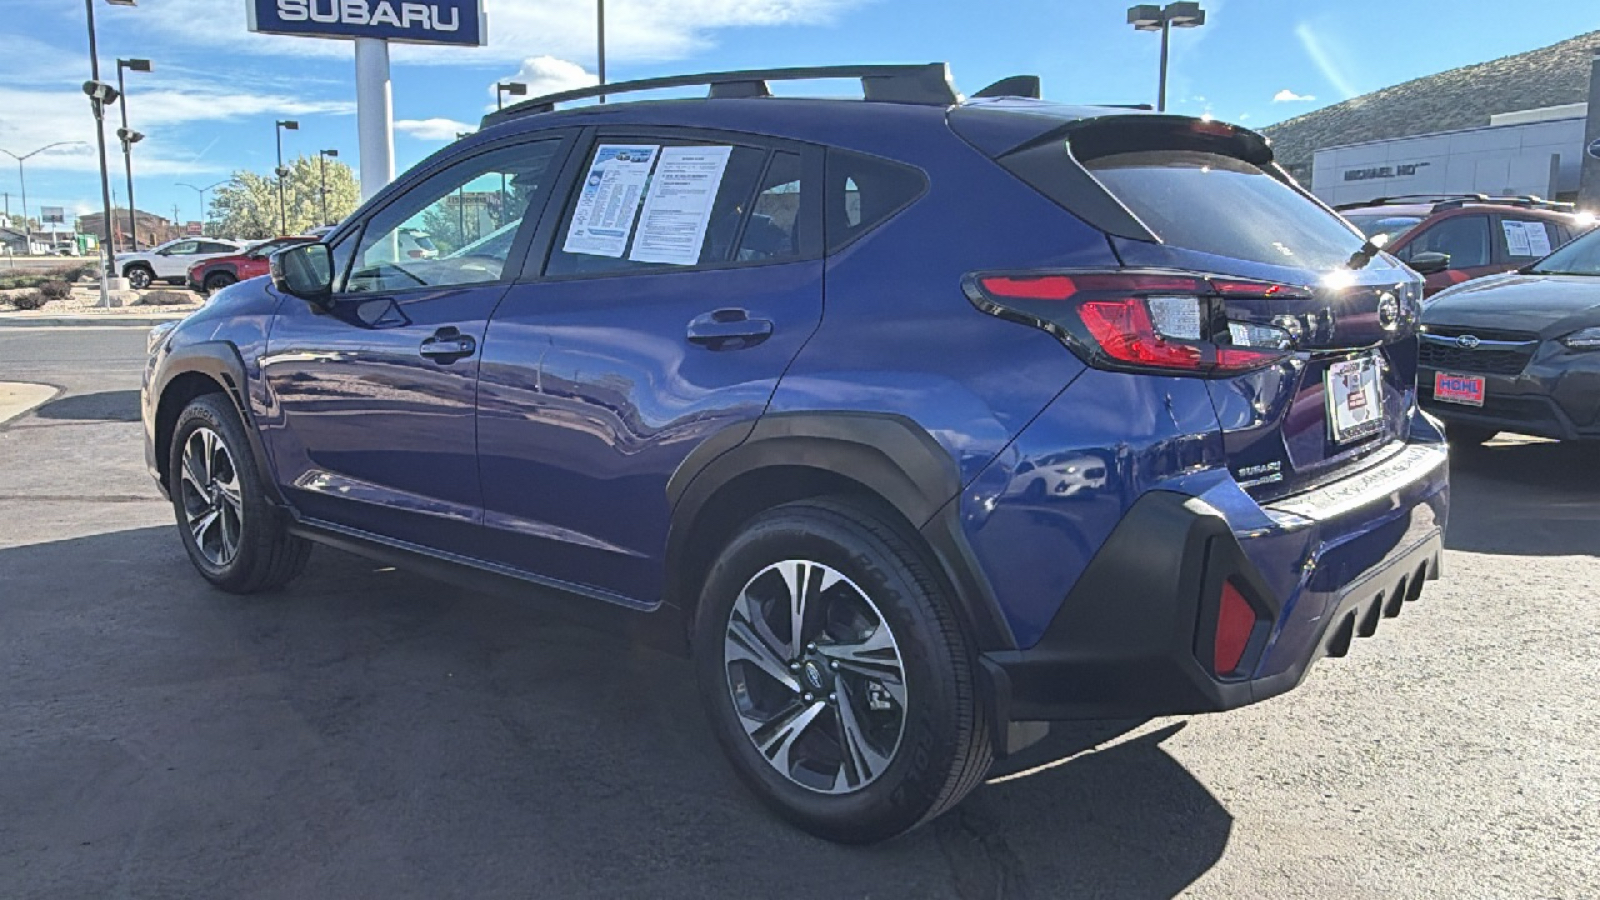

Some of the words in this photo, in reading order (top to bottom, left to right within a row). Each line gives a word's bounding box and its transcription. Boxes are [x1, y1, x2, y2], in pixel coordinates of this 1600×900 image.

[277, 0, 459, 31] SUBARU
[1344, 167, 1395, 181] MICHAEL
[1440, 379, 1478, 394] HOHL
